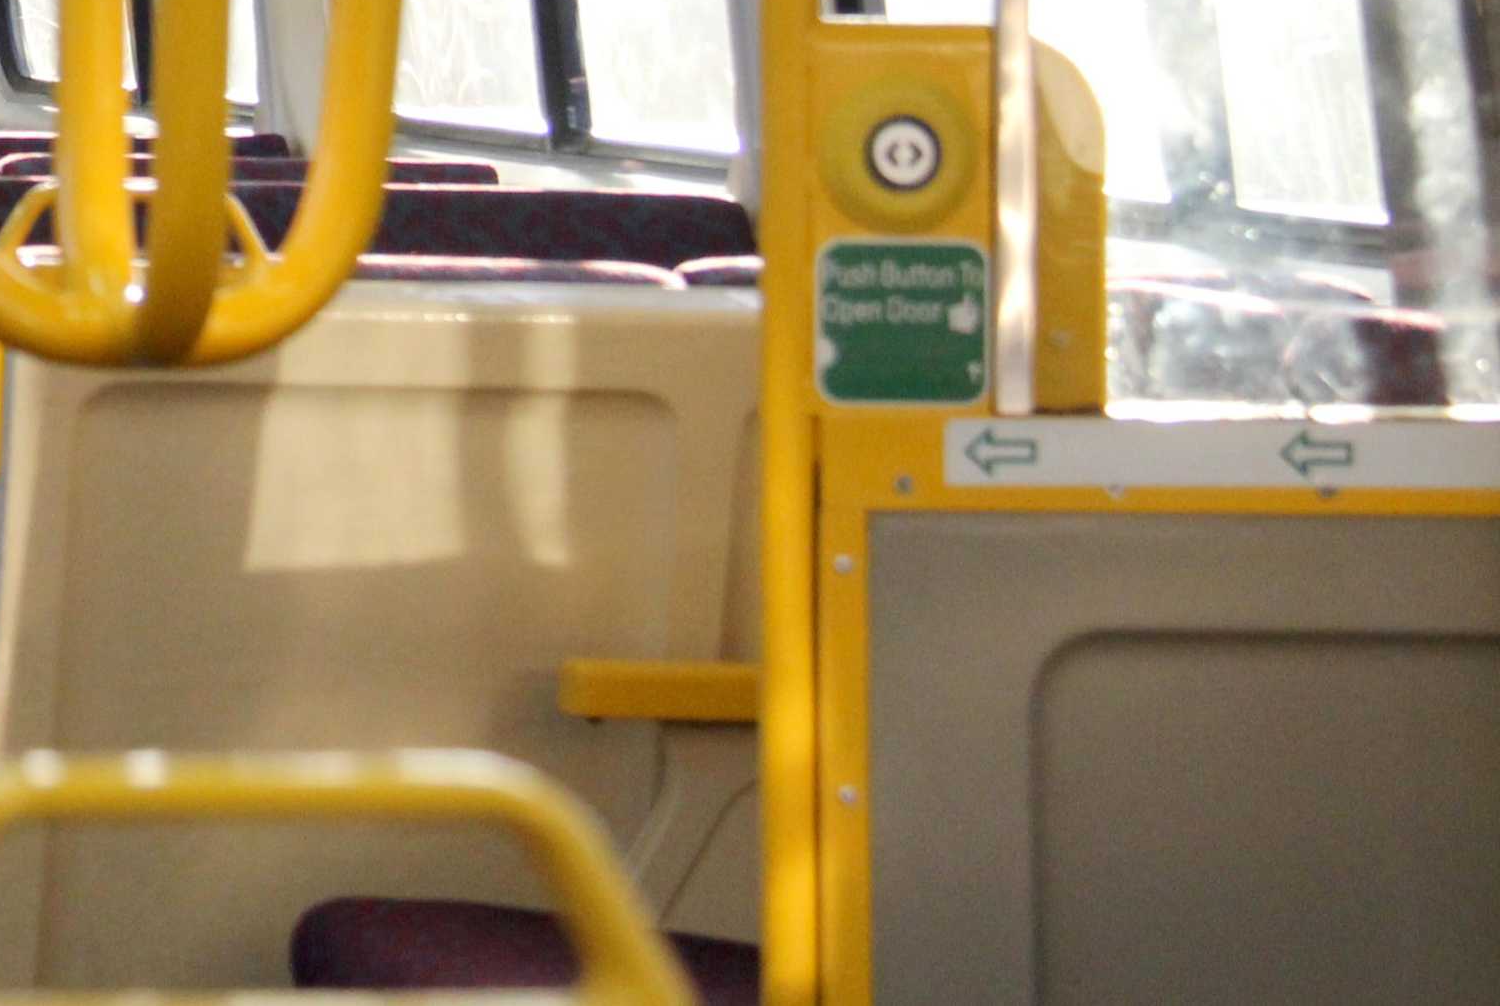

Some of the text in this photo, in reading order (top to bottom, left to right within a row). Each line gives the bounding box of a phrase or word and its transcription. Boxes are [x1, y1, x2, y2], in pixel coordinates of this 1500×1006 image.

[825, 258, 877, 288] Push
[879, 259, 956, 289] Button
[824, 293, 942, 327] Open Door
